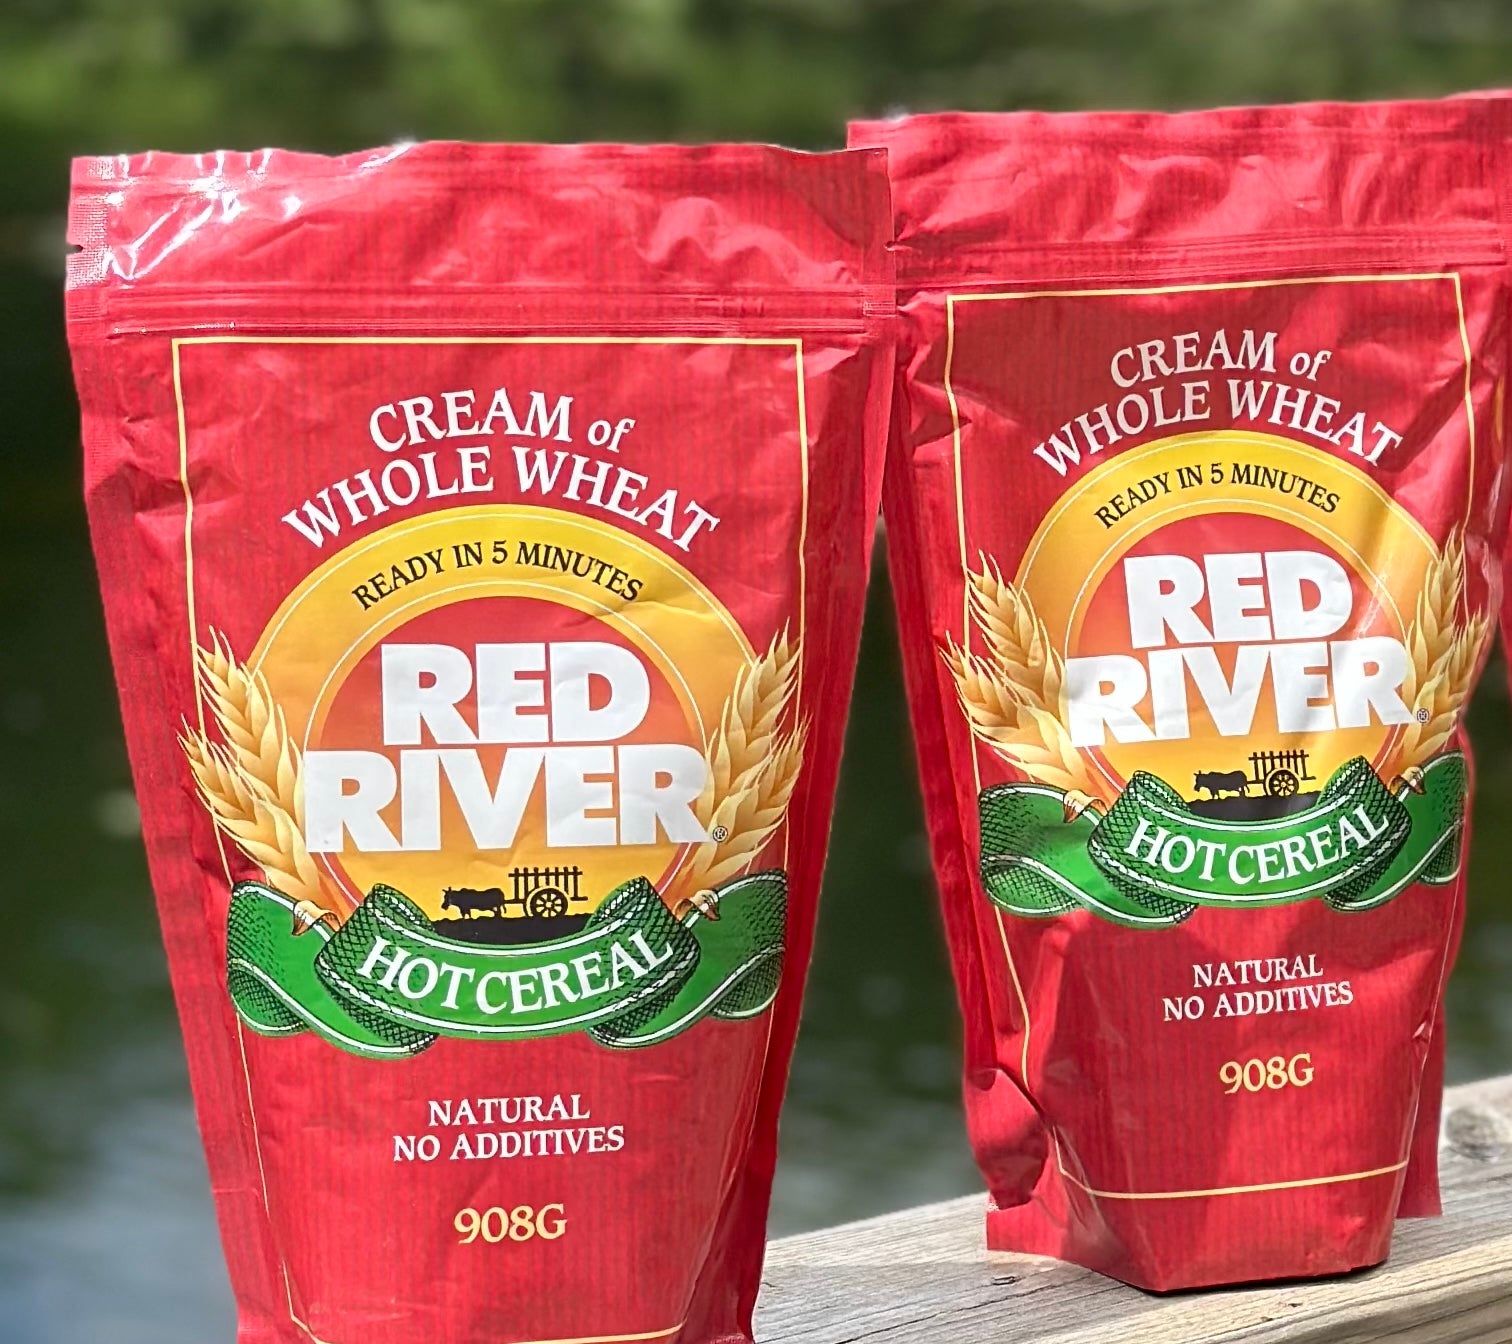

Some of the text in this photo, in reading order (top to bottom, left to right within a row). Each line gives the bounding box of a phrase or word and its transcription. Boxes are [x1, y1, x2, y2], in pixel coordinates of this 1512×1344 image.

[1110, 329, 1331, 389] CREAM of
[368, 389, 635, 452] CREAM of
[1033, 380, 1403, 479] WHOLE WHEAT
[282, 448, 719, 554] WHOLE WHEAT
[1094, 463, 1341, 529] READY IN 5 MINUTES
[351, 542, 643, 610] READY IN 5 MINUTES
[1124, 551, 1352, 649] RED
[381, 641, 649, 746] RED
[1065, 636, 1418, 747] RIVER
[303, 744, 716, 853] RIVER
[1125, 805, 1389, 885] HOT CEREAL
[358, 927, 674, 1015] HOT CEREAL
[1162, 981, 1354, 1022] NO ADDITIVES
[1193, 954, 1323, 988] NATURAL
[1219, 1054, 1314, 1094] 908G
[393, 1126, 624, 1162] NO ADDITIVES
[427, 1094, 590, 1127] NATURAL
[454, 1204, 567, 1244] 908G
